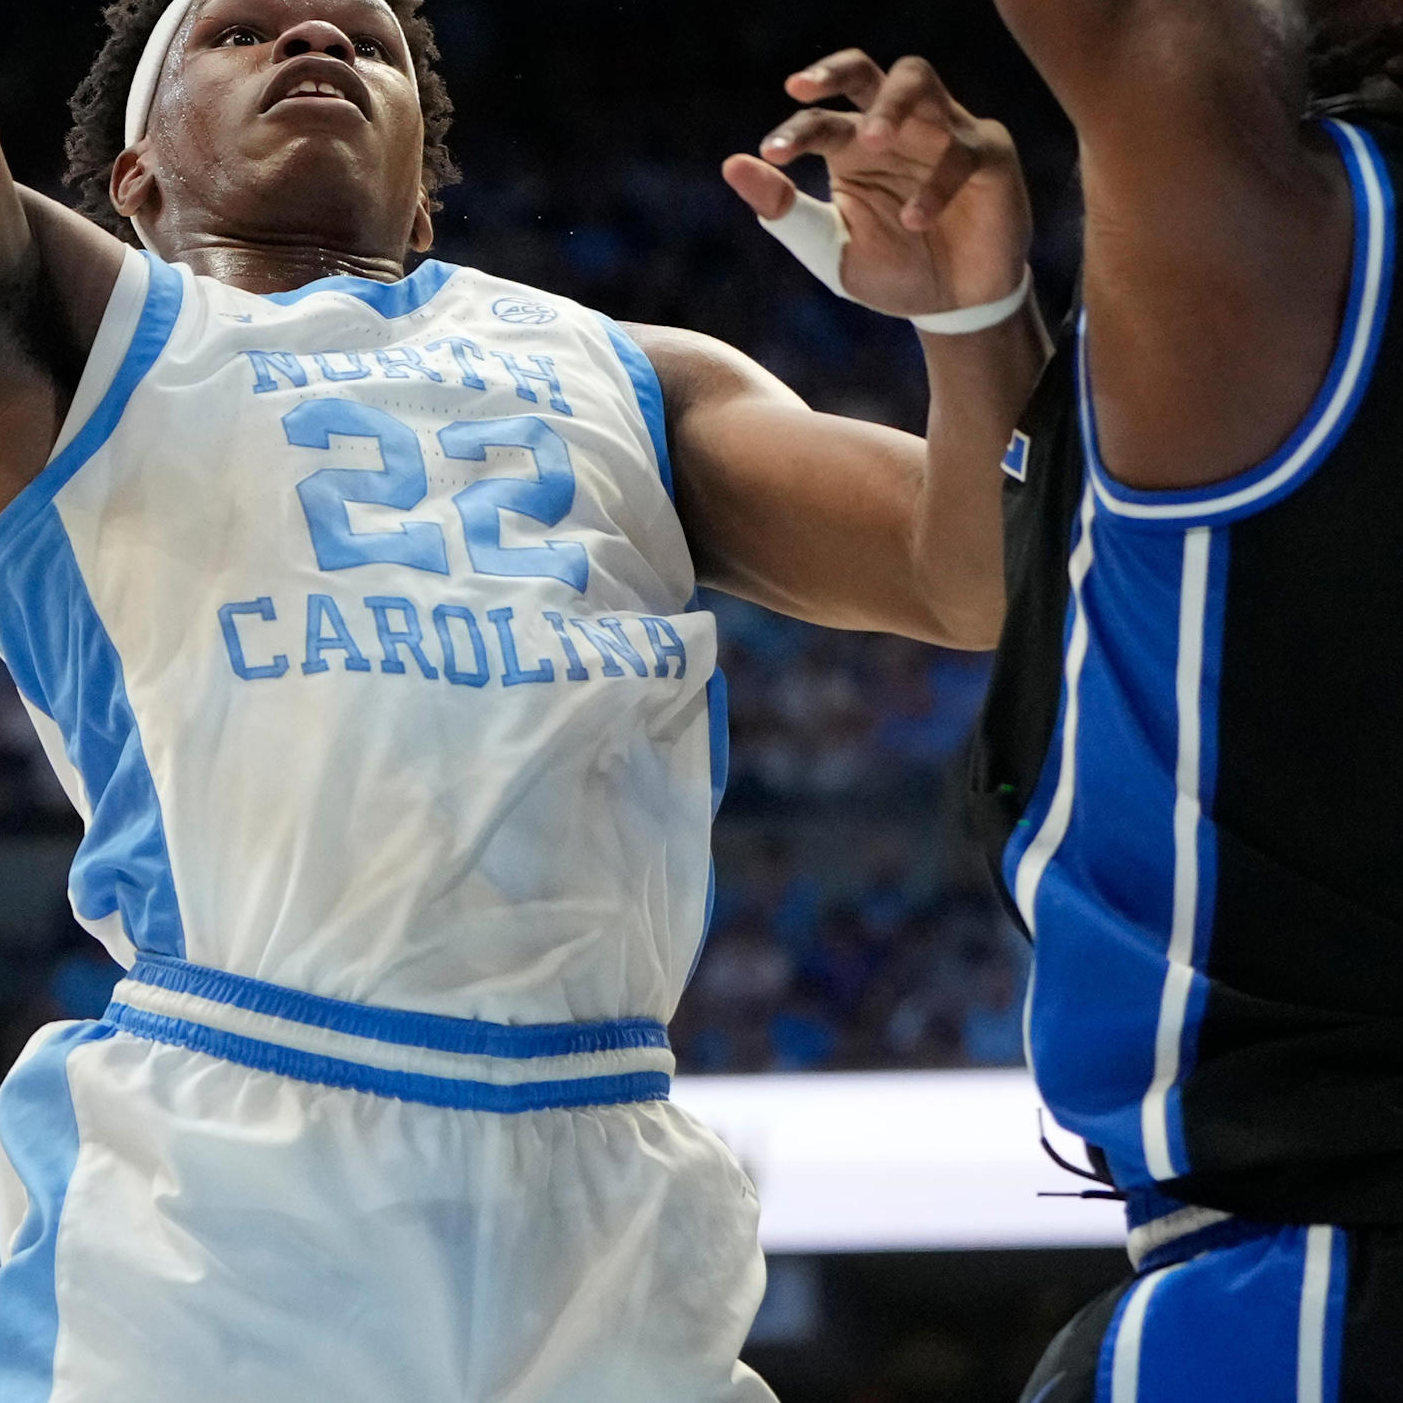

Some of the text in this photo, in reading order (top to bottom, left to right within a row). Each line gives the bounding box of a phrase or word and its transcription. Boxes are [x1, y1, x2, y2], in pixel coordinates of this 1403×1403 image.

[239, 337, 573, 416] NORTH
[281, 398, 589, 594] 22
[217, 594, 687, 689] CAROLINA
